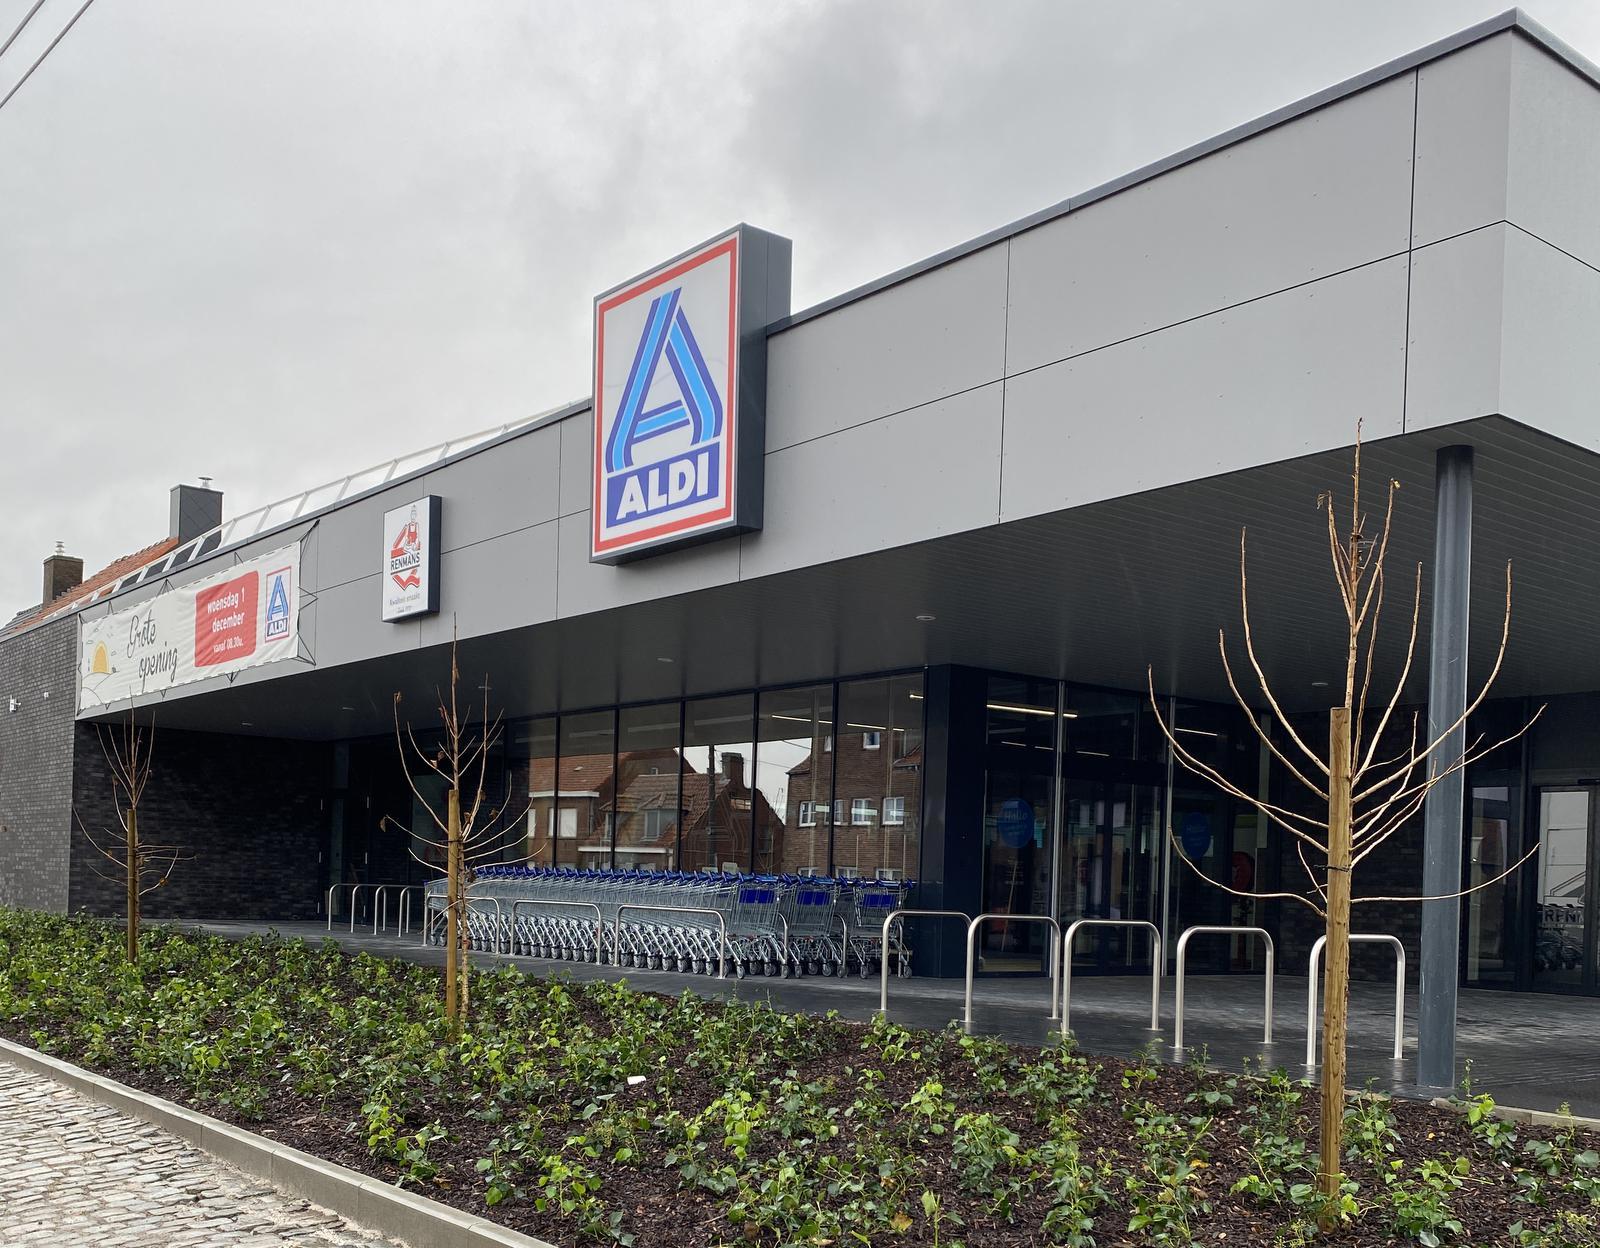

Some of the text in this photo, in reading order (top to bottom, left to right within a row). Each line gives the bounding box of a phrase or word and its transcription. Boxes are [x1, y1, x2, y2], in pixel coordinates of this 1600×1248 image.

[615, 451, 709, 521] ALDI
[390, 552, 420, 571] RENMANS
[207, 586, 245, 614] woensdag 1
[127, 609, 156, 658] Grote
[212, 612, 245, 633] december
[268, 620, 287, 636] ALDI
[213, 640, 226, 654] vanaf
[138, 641, 178, 693] opening
